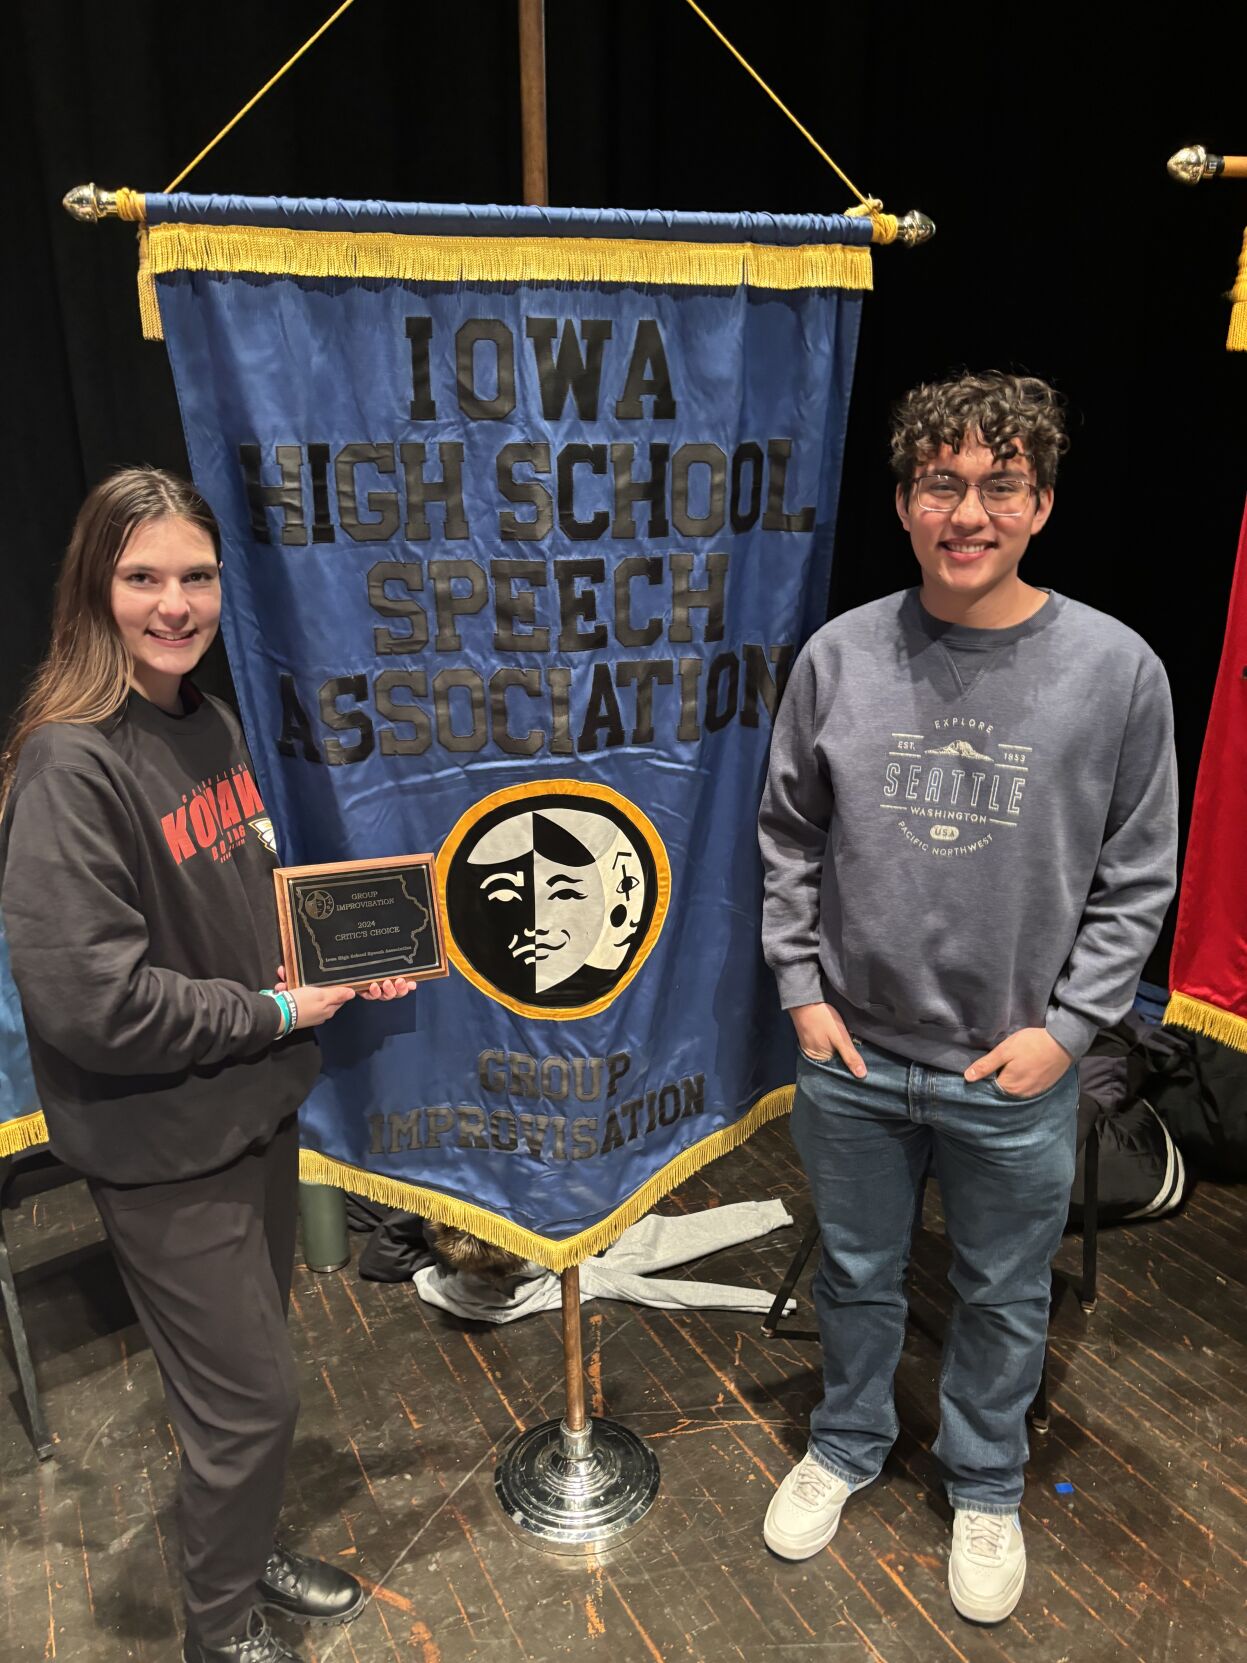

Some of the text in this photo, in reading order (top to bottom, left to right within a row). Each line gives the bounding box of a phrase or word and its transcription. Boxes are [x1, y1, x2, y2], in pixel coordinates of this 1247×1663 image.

[405, 316, 677, 421] IOWA
[239, 437, 816, 546] HIGH SCHOOL
[366, 553, 731, 656] SPEECH
[278, 643, 795, 767] ASSOCIATION
[934, 717, 994, 734] EXPLORE
[897, 740, 1027, 763] EST. 1853
[883, 762, 1026, 814] SEATTLE
[910, 805, 988, 825] WASHINGTON
[898, 819, 994, 857] PACIFIC NORTHWEST
[934, 828, 956, 838] USA
[335, 899, 395, 911] IMPROVISATION
[351, 890, 378, 900] GROUP
[335, 926, 400, 942] CRITIC'S CHOICE
[357, 920, 376, 929] 2024
[477, 1048, 632, 1102] GROUP
[367, 1071, 706, 1161] IMPROVISATION
